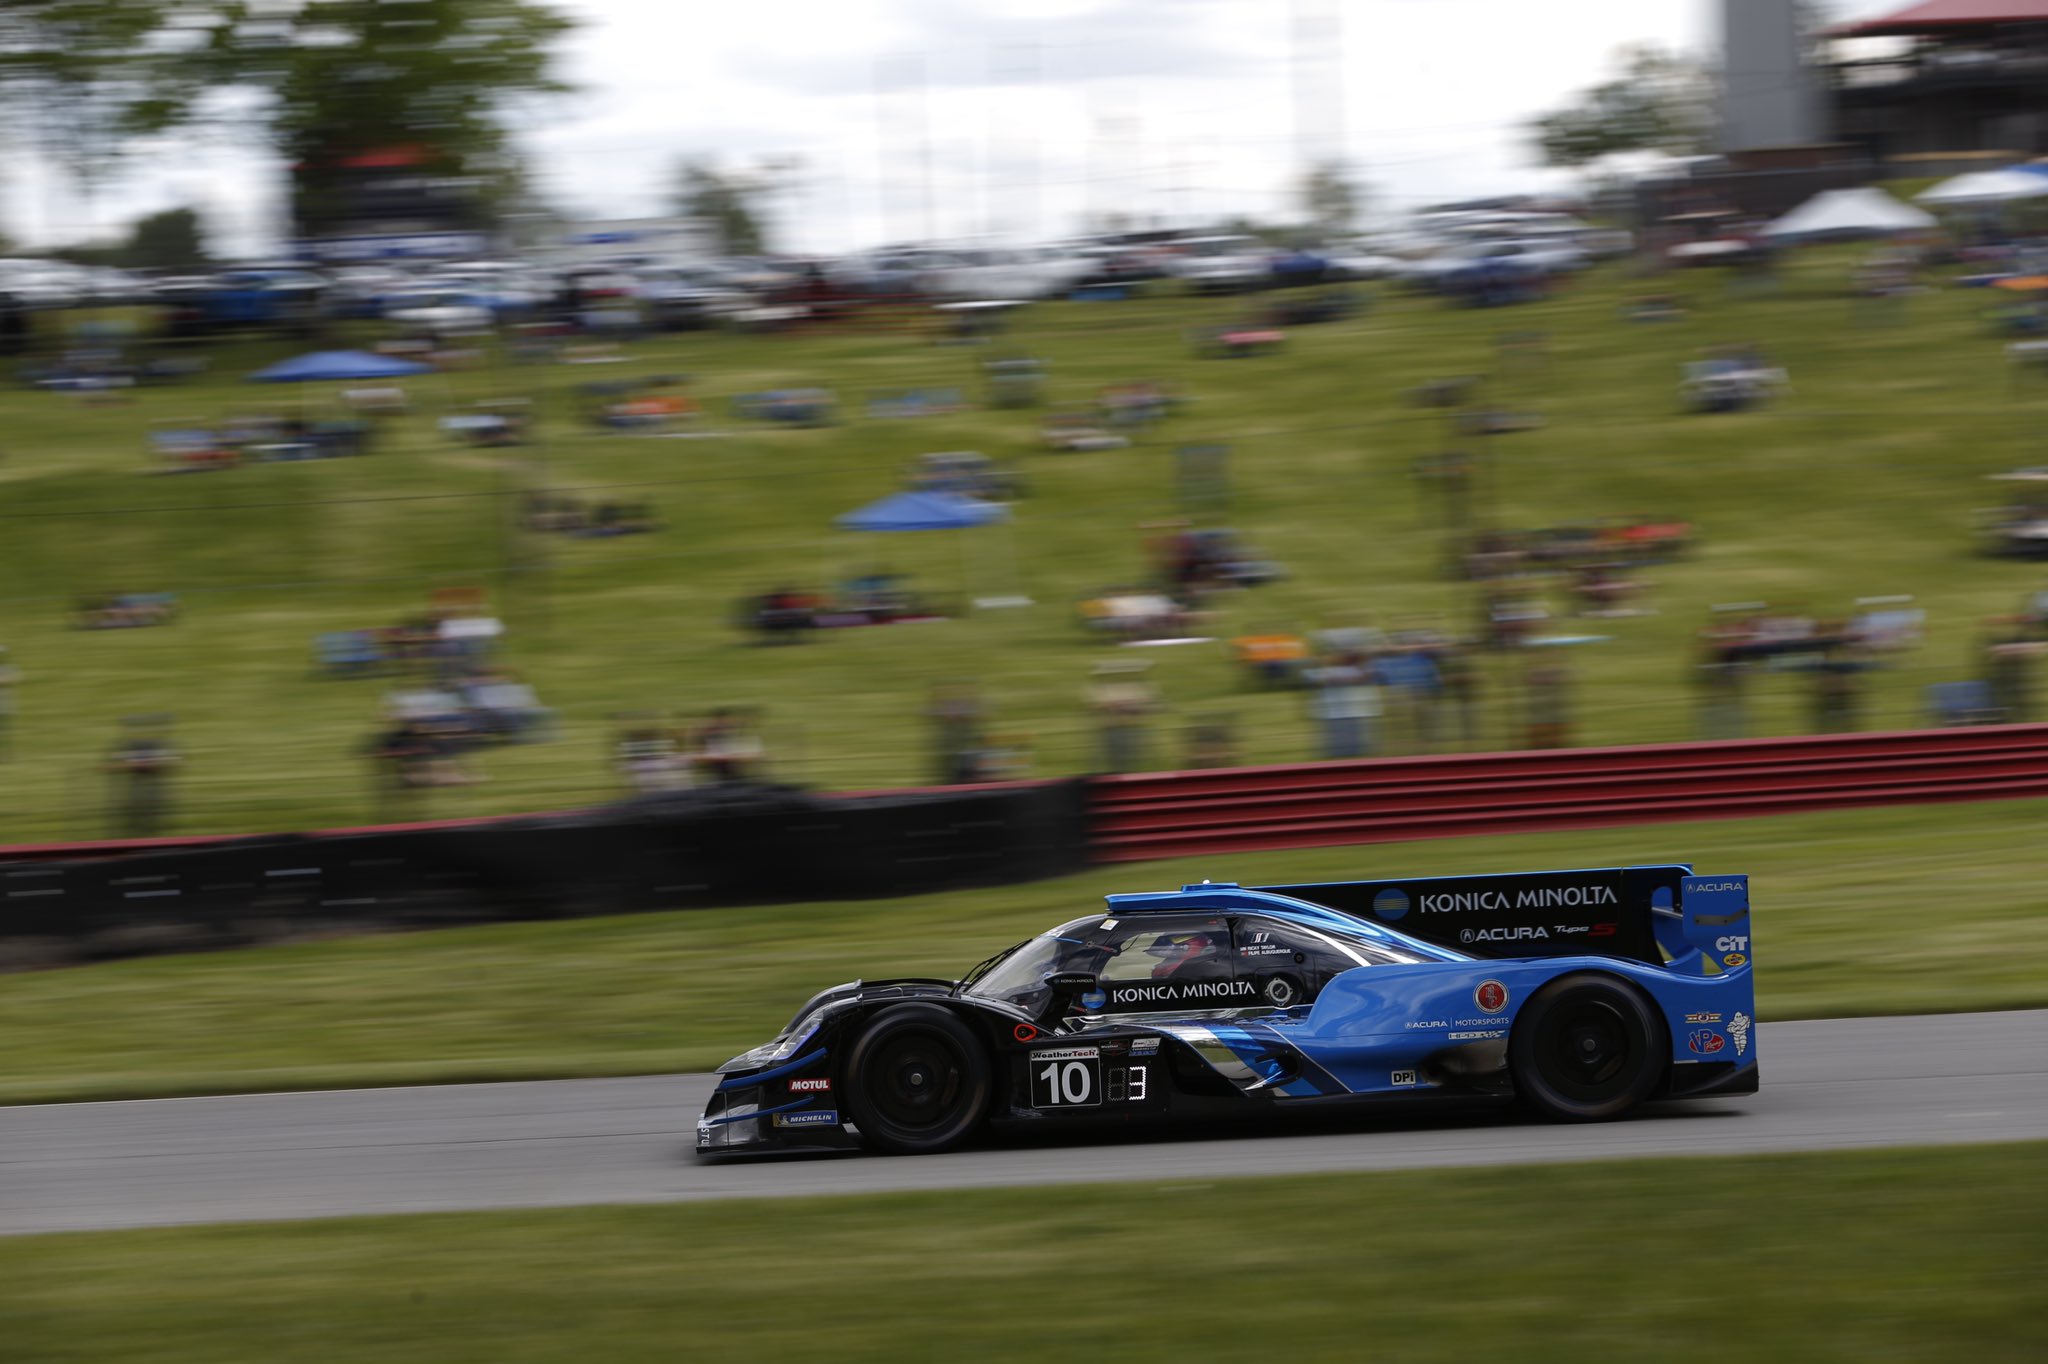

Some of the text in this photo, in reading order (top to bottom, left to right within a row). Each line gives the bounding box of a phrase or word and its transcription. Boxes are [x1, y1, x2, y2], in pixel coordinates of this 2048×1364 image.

[1696, 883, 1743, 892] ACURA
[1420, 886, 1618, 913] KONICA MINOLTA
[1475, 923, 1617, 941] ACURA Type S
[1113, 981, 1256, 1003] KONICA MINOLTA
[1455, 1017, 1510, 1026] MOTORSPORTS
[1031, 1049, 1096, 1059] WeatherTech
[1040, 1061, 1091, 1104] 10
[1128, 1066, 1146, 1100] 3
[1393, 1072, 1415, 1083] DPi
[791, 1079, 829, 1090] MOTUL
[790, 1114, 832, 1123] MICHELIN
